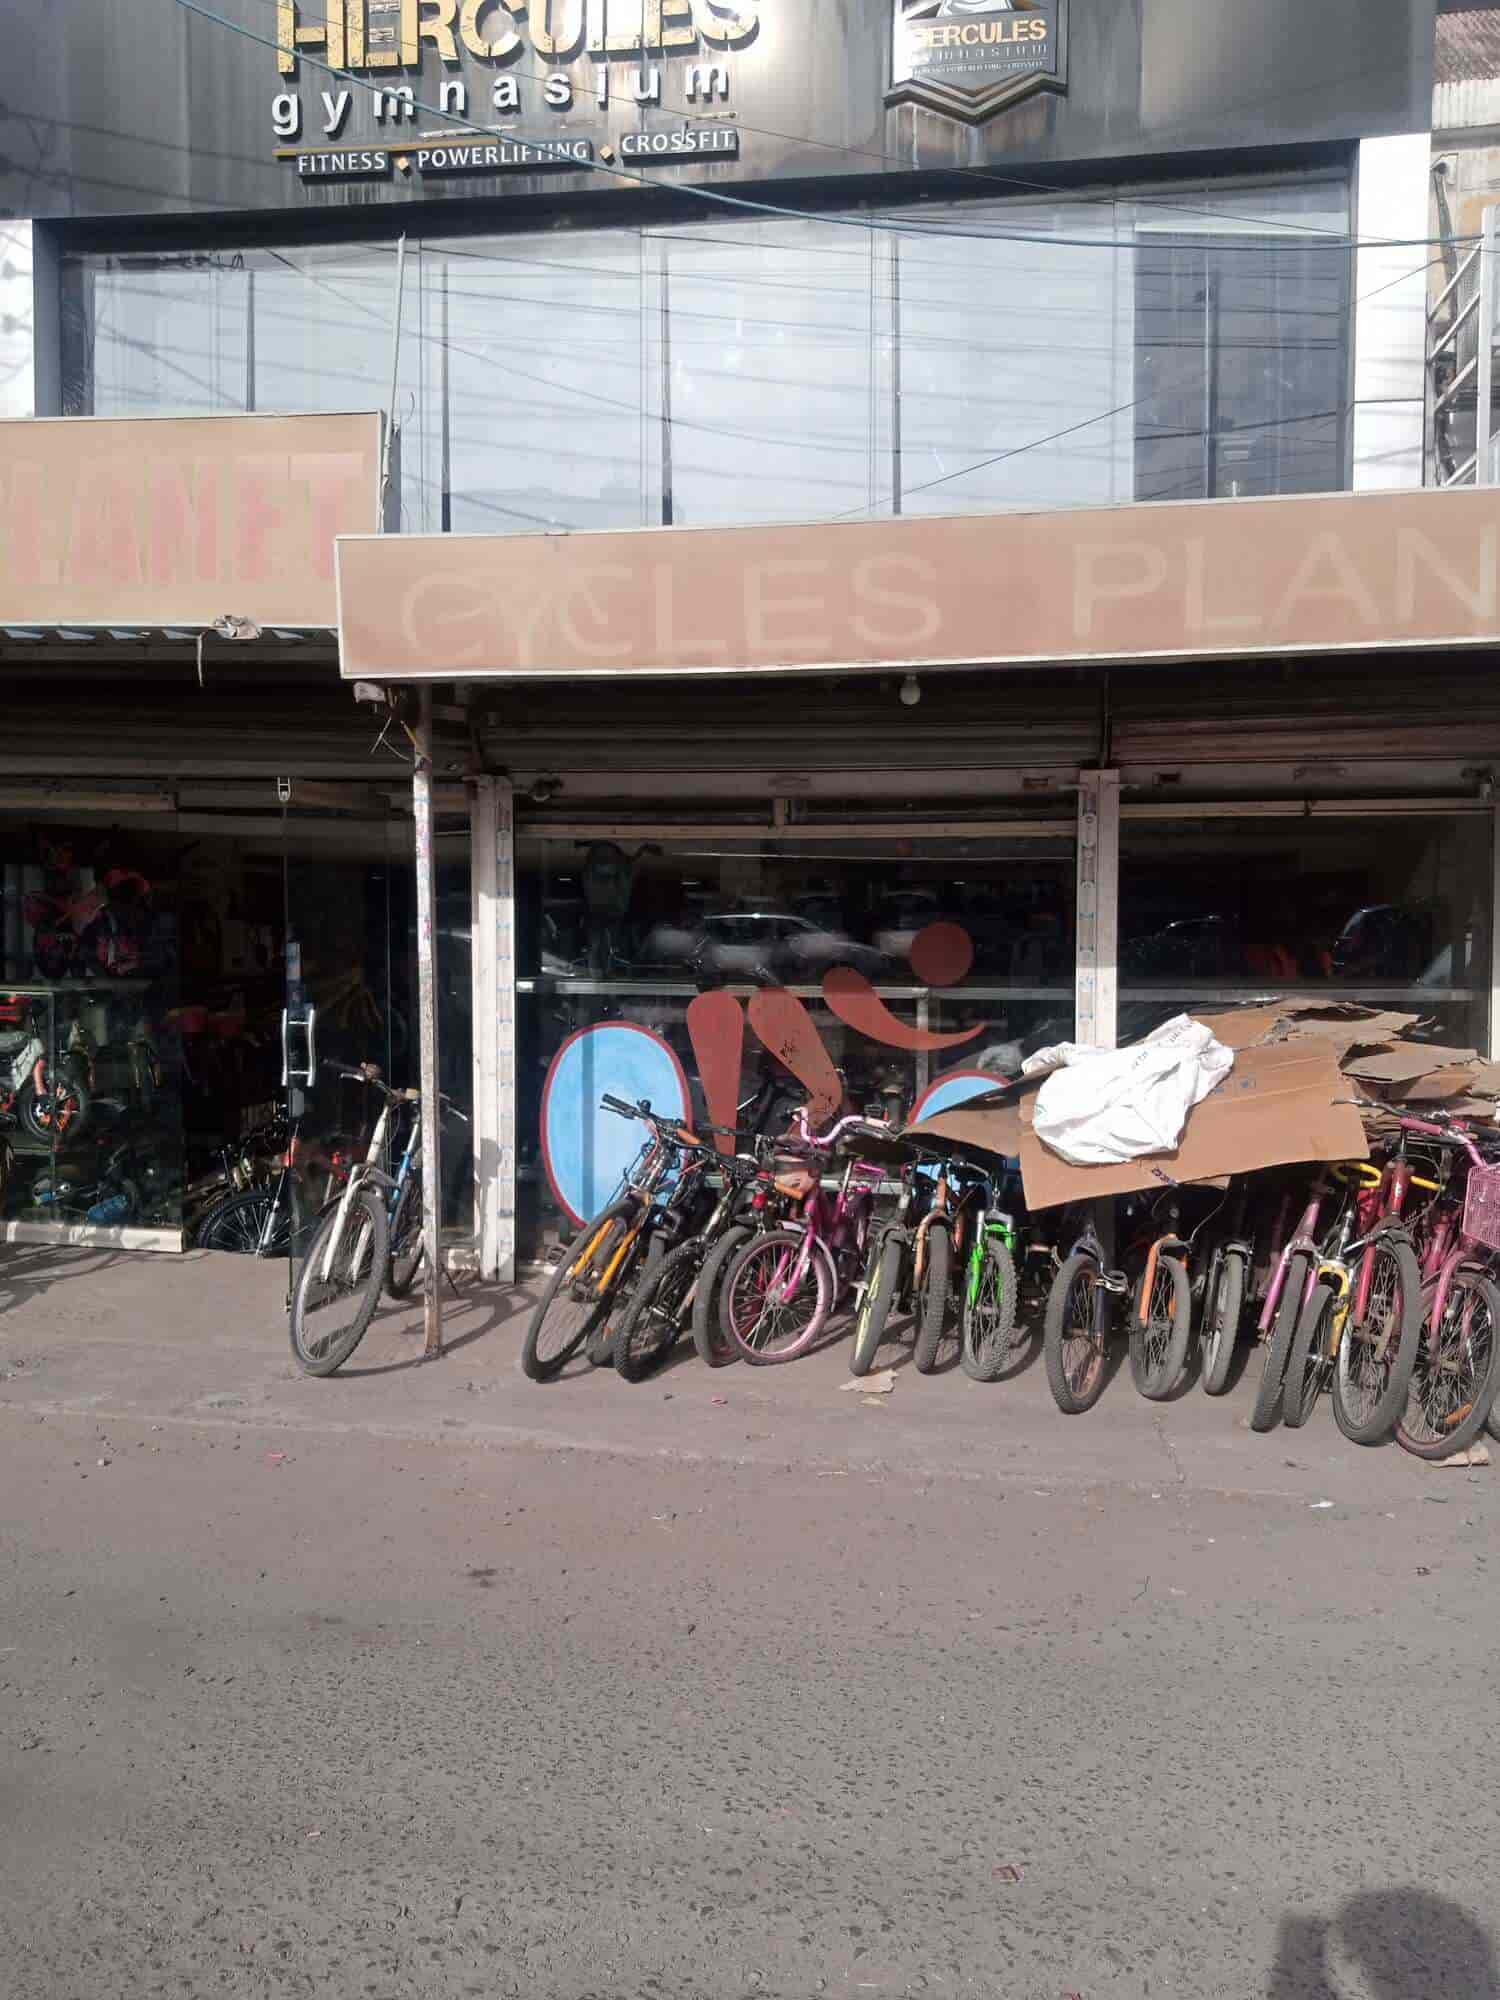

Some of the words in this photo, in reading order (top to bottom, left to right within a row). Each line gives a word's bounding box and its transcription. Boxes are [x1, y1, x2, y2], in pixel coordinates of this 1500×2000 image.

[277, 0, 760, 73] HERCULES
[271, 62, 729, 136] gymnasium
[298, 152, 386, 173] FITNESS
[418, 141, 588, 168] POWERLIFTING
[621, 130, 736, 153] CROSSFIT
[400, 553, 943, 666] CYCLES
